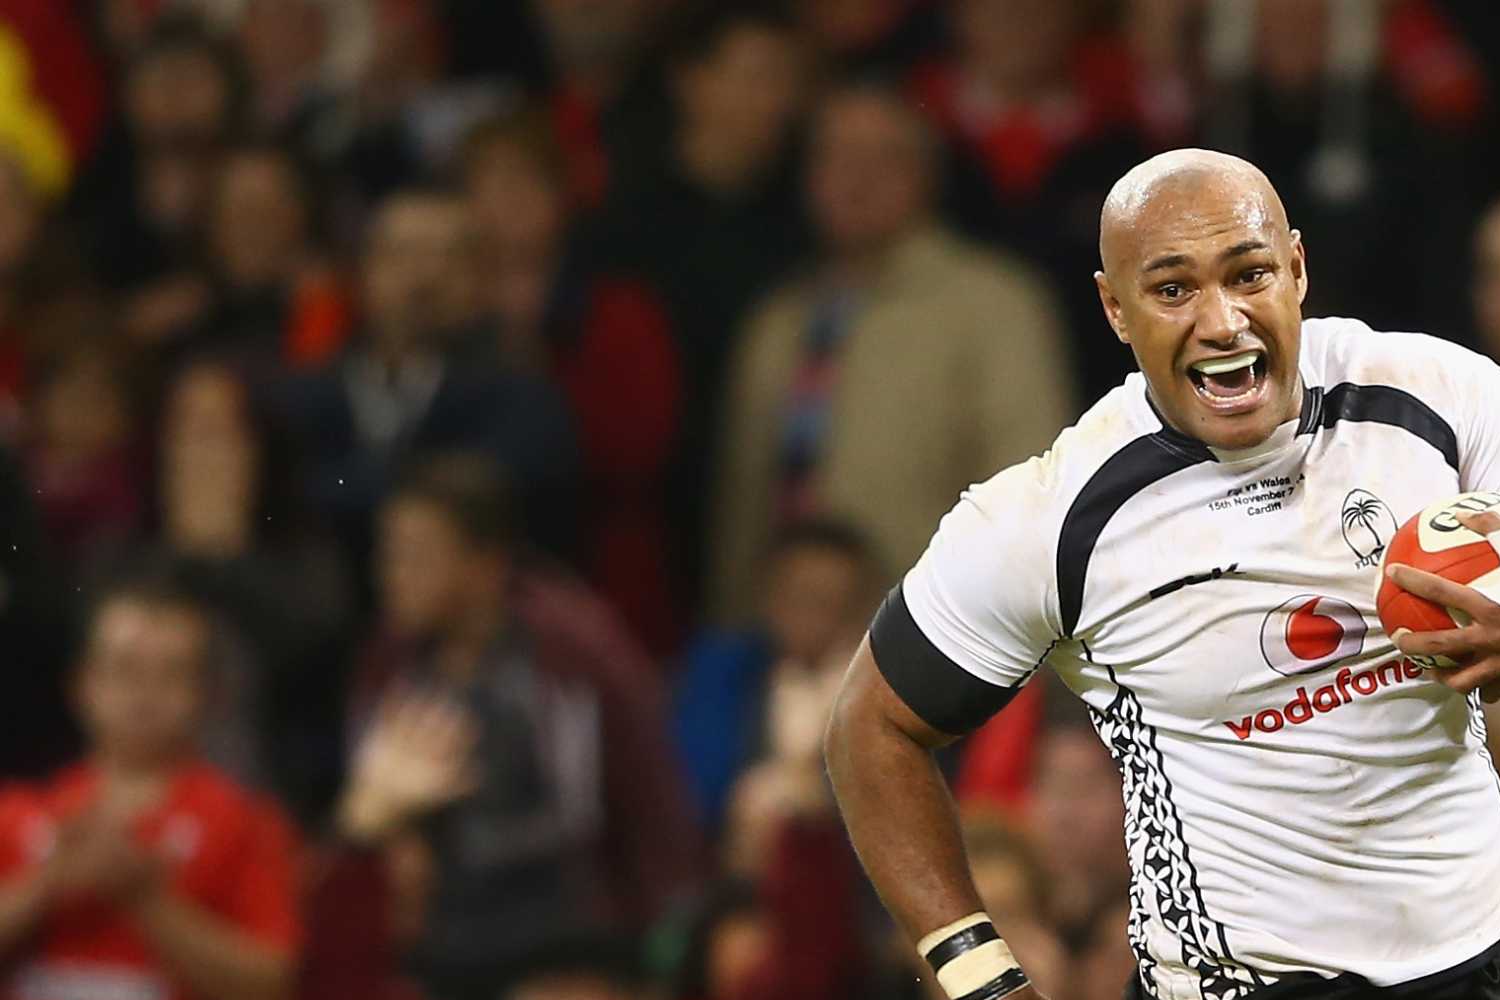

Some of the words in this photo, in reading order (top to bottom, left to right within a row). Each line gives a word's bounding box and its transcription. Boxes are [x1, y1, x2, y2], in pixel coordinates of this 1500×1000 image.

[1208, 500, 1233, 511] 15th
[1233, 489, 1286, 506] November
[1247, 501, 1282, 516] Cardiff
[1222, 657, 1423, 740] vodafone
